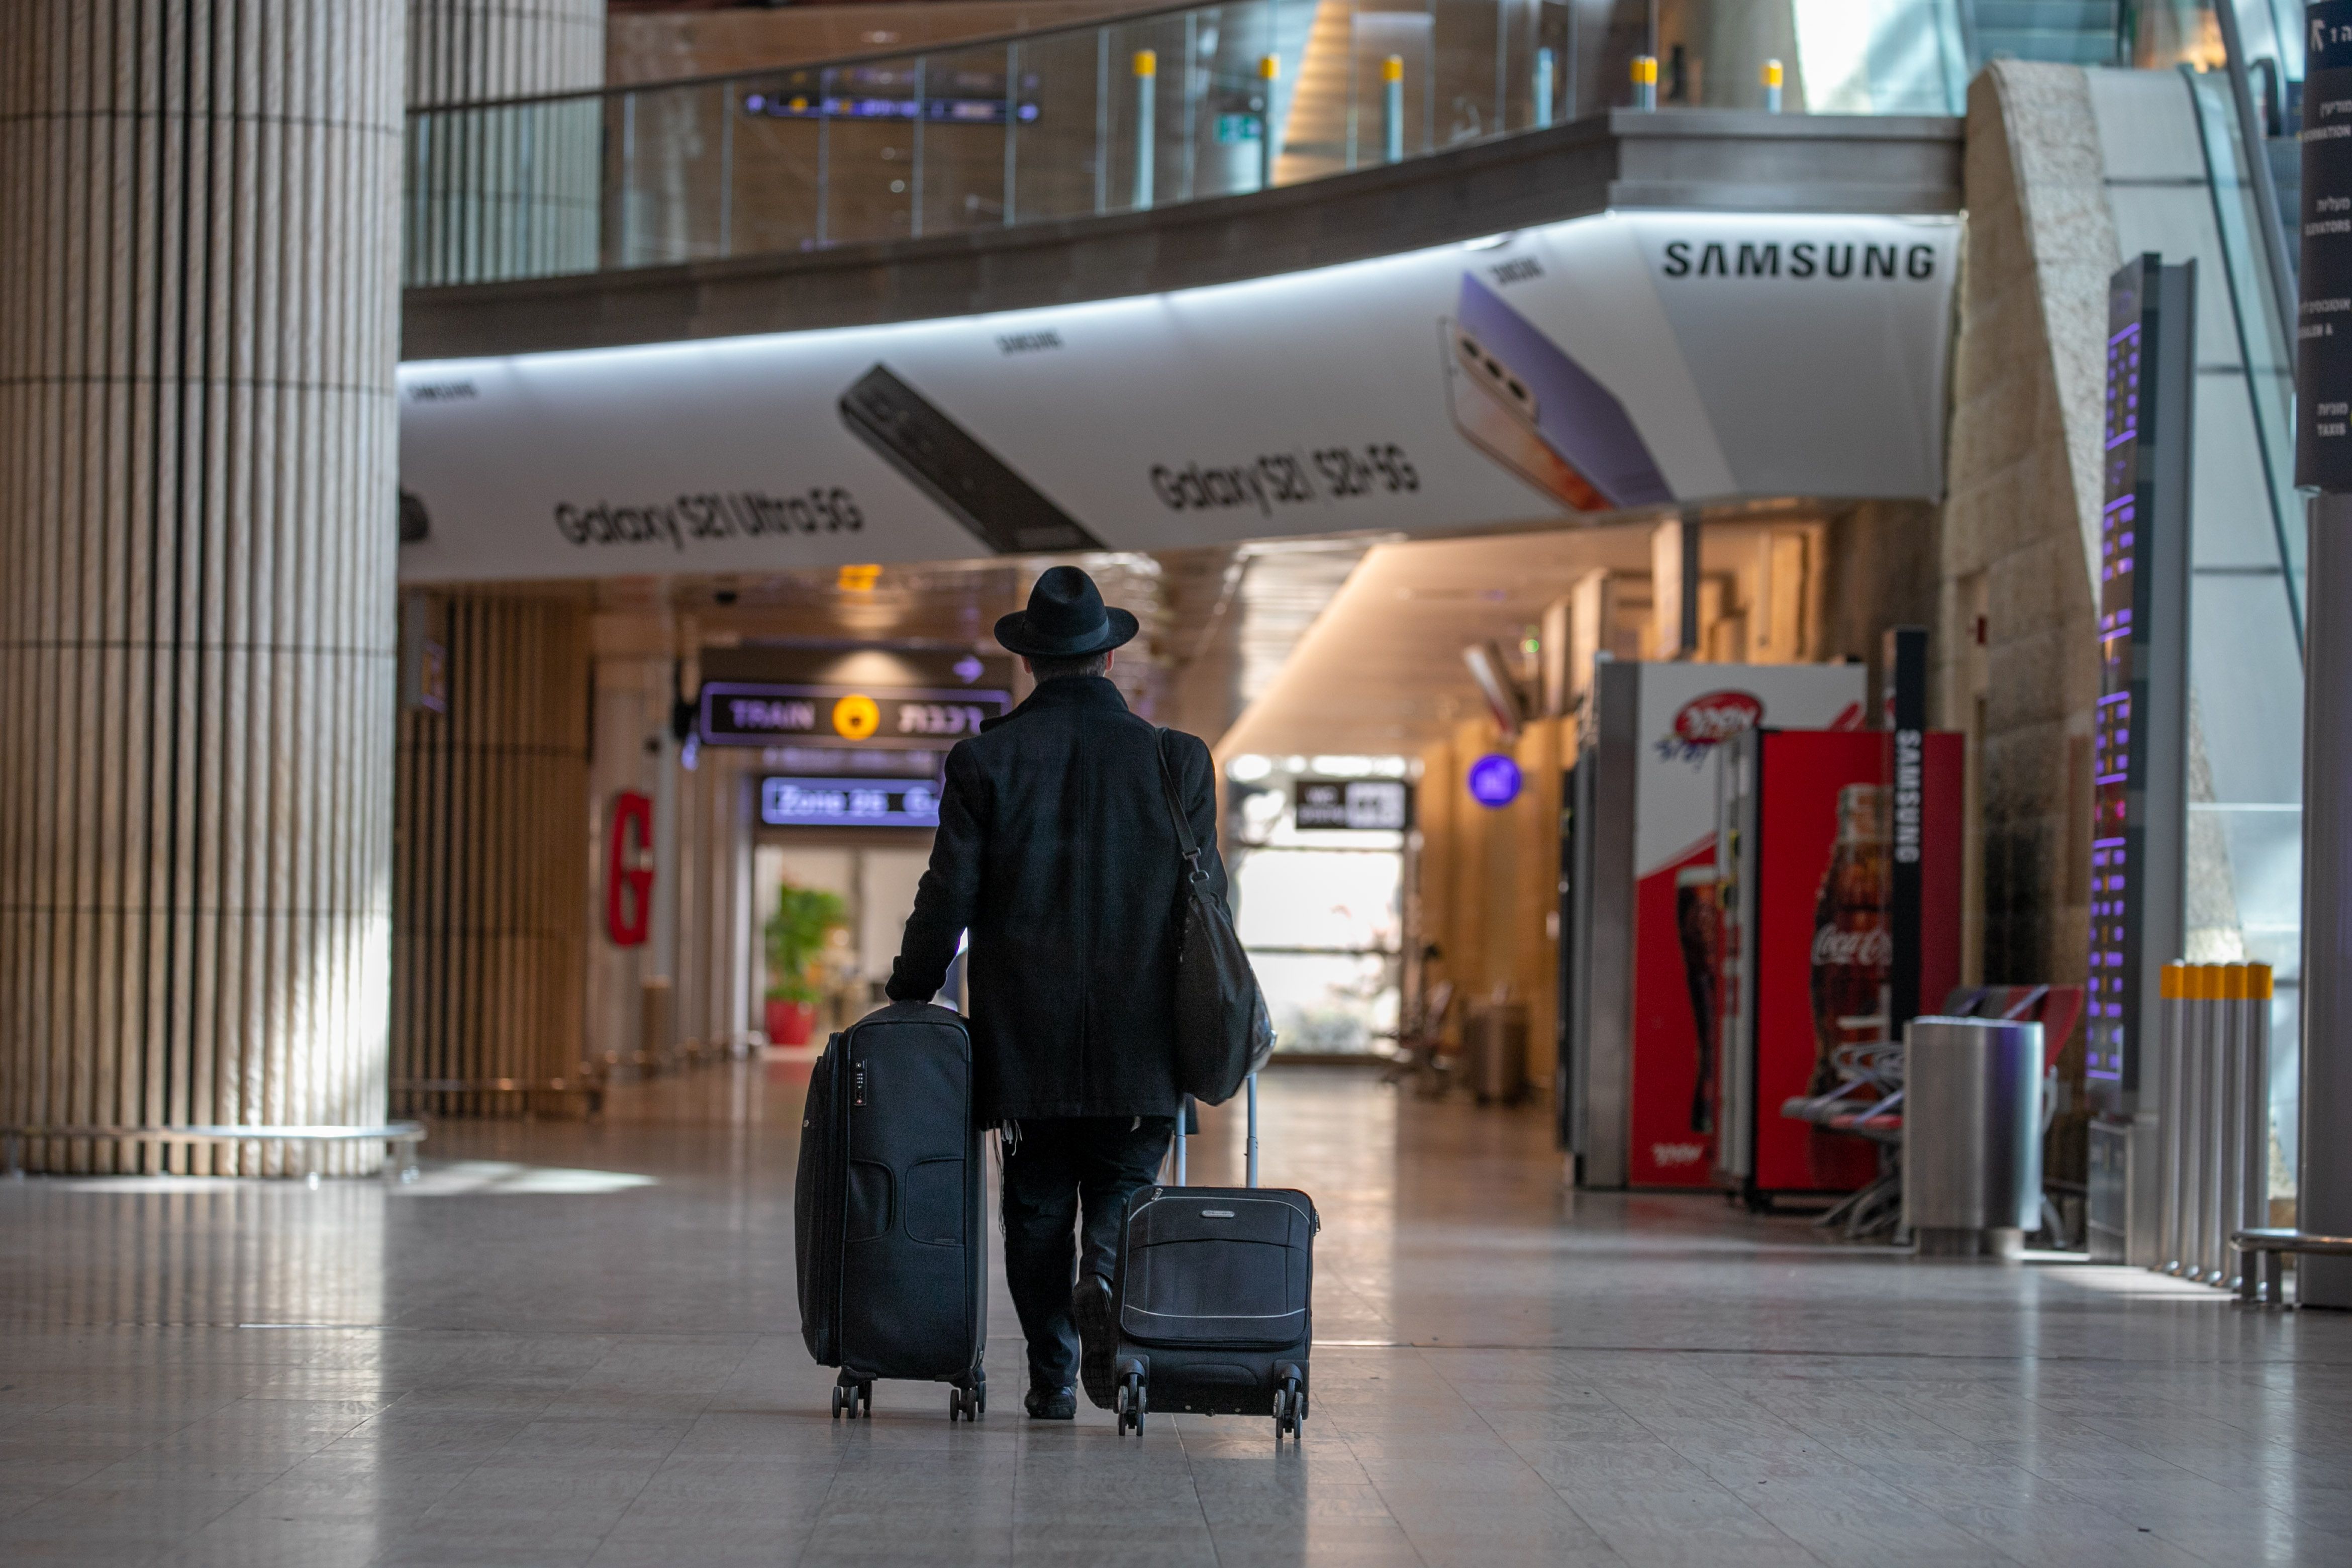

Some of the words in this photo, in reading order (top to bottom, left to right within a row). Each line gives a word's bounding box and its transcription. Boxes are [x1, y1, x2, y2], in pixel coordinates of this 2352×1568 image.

[1664, 241, 1936, 279] SAMSUNG
[1149, 460, 1272, 517] Galaxy
[1365, 443, 1420, 494] 5G
[555, 500, 685, 553] Galaxy
[677, 494, 736, 541] S21
[733, 491, 816, 538] Ultra
[809, 487, 864, 533] 5G
[729, 699, 815, 730] TRAIN
[1895, 729, 1922, 863] SAMSUNG
